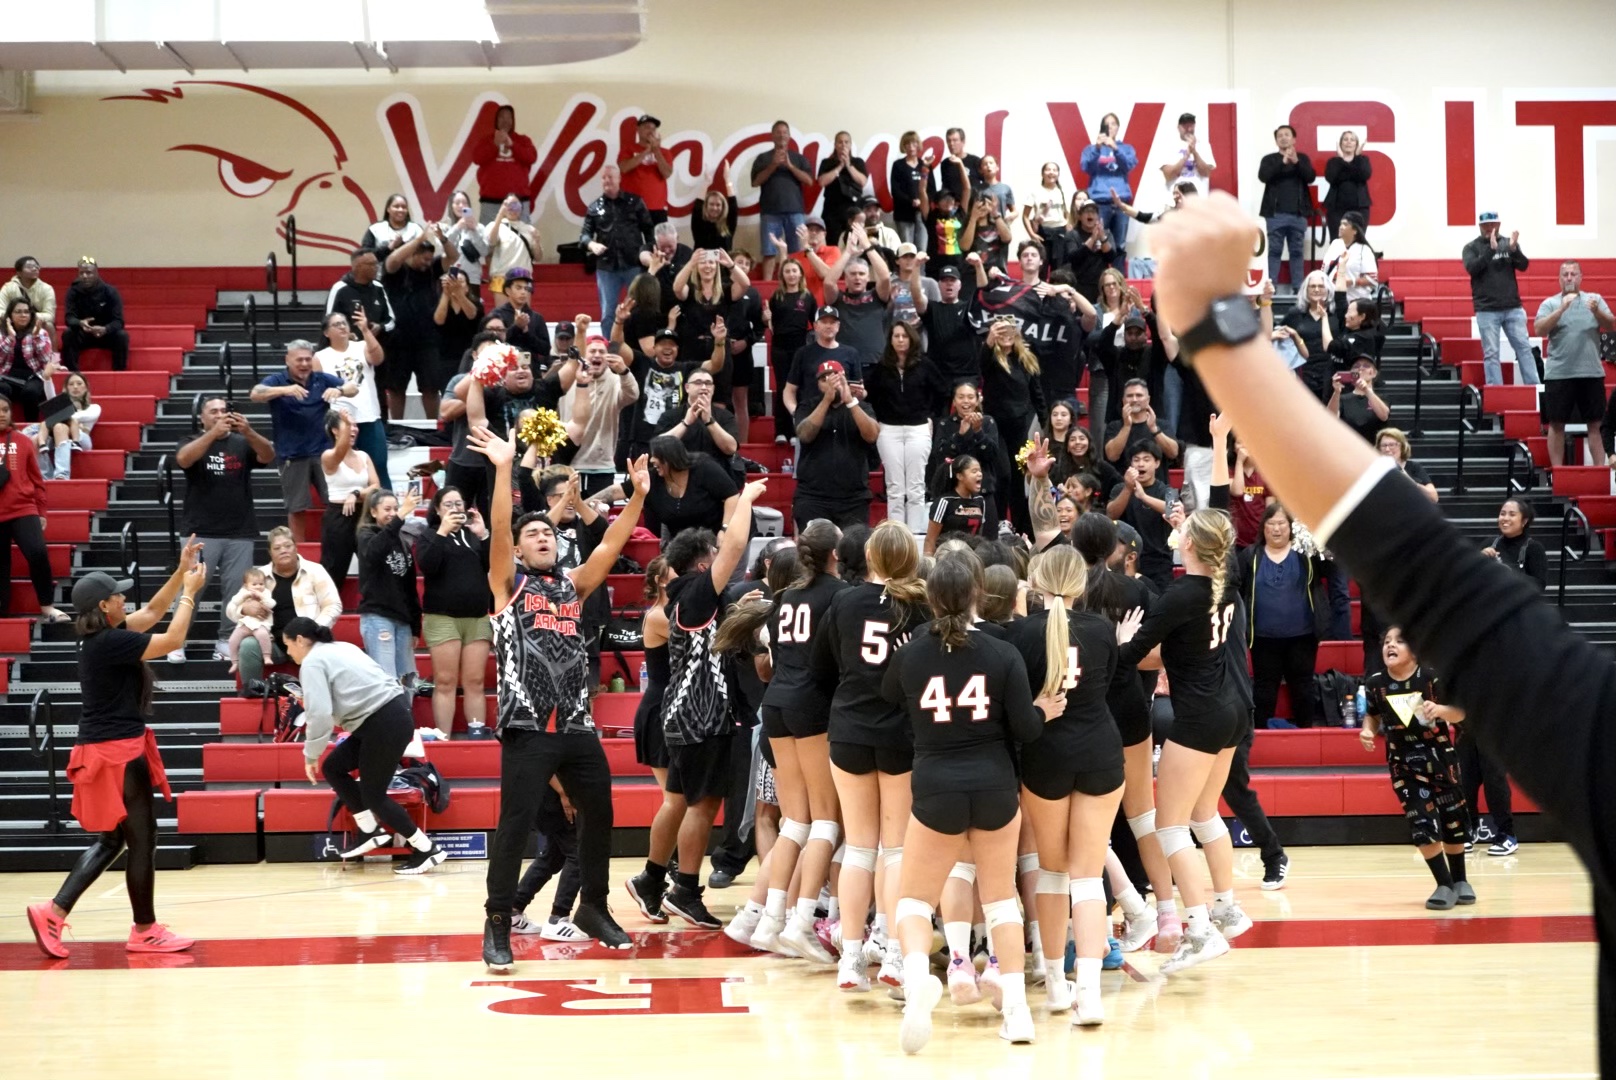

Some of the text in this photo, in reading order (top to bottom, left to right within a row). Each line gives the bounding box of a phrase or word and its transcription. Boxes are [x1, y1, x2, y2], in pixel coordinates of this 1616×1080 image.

[524, 592, 580, 618] ISLND
[777, 603, 811, 643] 20
[860, 620, 890, 665] 5
[919, 674, 990, 723] 44
